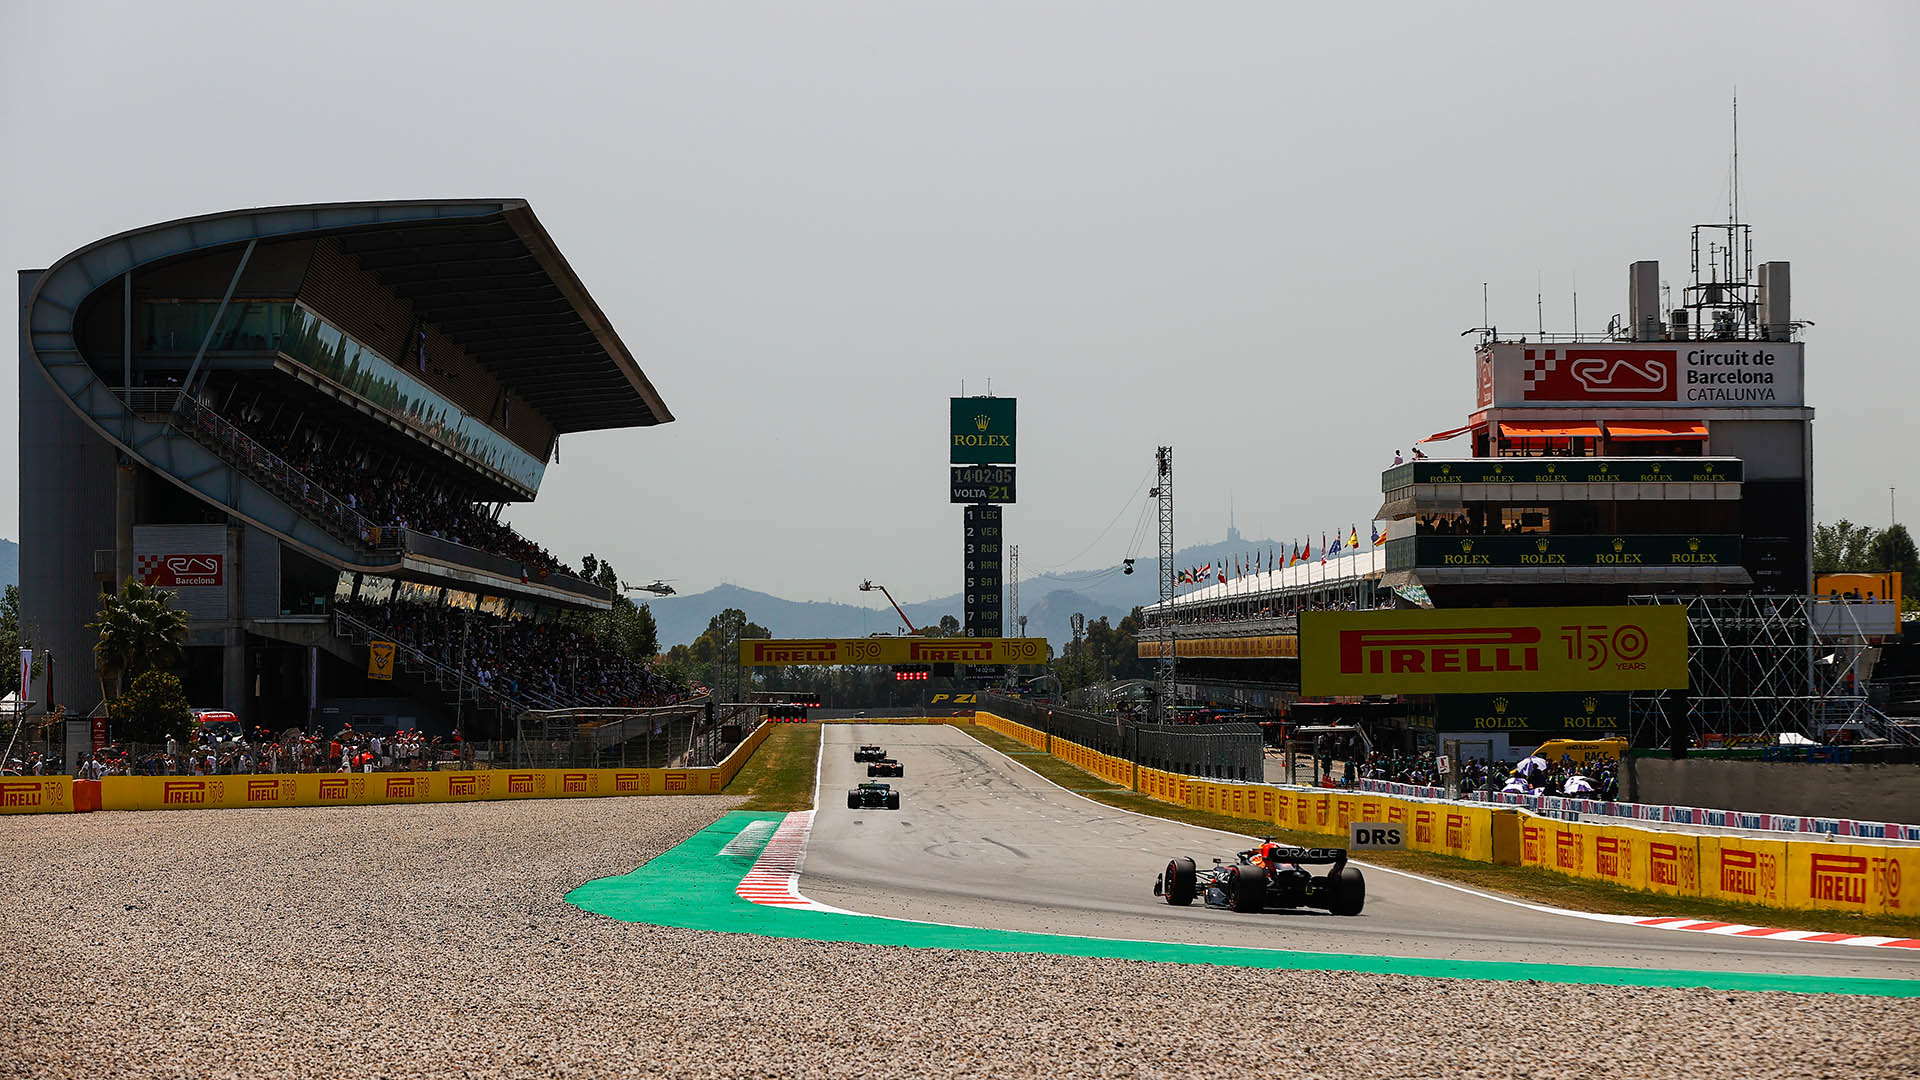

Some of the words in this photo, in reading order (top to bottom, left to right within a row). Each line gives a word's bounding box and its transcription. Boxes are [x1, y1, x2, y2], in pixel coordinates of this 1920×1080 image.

[1687, 350, 1748, 366] Circuit
[1752, 350, 1775, 366] de
[1687, 369, 1775, 385] Barcelona
[1687, 388, 1776, 401] CATALUNYA
[954, 435, 1011, 447] ROLEX
[955, 469, 1012, 484] 14:02:05
[1693, 474, 1725, 482] ROLEX
[954, 488, 987, 498] VOLTA
[988, 486, 1010, 500] 21
[967, 511, 975, 520] 1
[981, 511, 998, 519] LEC
[967, 527, 975, 536] 2
[981, 527, 998, 535] VER
[967, 544, 975, 554] 3
[981, 544, 998, 553] RUS
[967, 561, 975, 570] 4
[1444, 554, 1490, 565] ROLEX
[1520, 554, 1566, 565] ROLEX
[1596, 553, 1642, 564] ROLEX
[1672, 553, 1718, 564] ROLEX
[175, 577, 216, 585] Barcelona
[967, 578, 975, 587] 5
[967, 594, 975, 604] 6
[981, 594, 998, 603] PER
[967, 611, 975, 621] 7
[967, 628, 975, 637] 8
[754, 642, 837, 662] PIRELLI
[845, 641, 881, 661] 150
[910, 641, 993, 661] PIRELLI
[1001, 641, 1037, 661] 150
[1340, 626, 1541, 674] PIRELLI
[1560, 625, 1649, 671] 150
[1615, 662, 1647, 671] YEARS
[931, 693, 950, 704] P
[1474, 717, 1529, 728] ROLEX
[1563, 717, 1618, 728] ROLEX
[386, 778, 415, 798] PIRELLI
[449, 775, 476, 796] PIRELLI
[508, 774, 534, 793] PIRELLI
[563, 774, 587, 792] PIRELLI
[616, 773, 639, 791] PIRELLI
[0, 783, 41, 807] PIRELLI
[164, 782, 205, 804] PIRELLI
[248, 780, 279, 801] PIRELLI
[319, 779, 349, 800] PIRELLI
[1356, 829, 1401, 846] DRS
[1275, 848, 1338, 860] ORACLE
[1556, 830, 1574, 869] PIRELLI
[1596, 836, 1618, 877] PIRELLI
[1650, 842, 1678, 887] PIRELLI
[1720, 847, 1757, 896] PIRELLI
[1810, 853, 1867, 904] PIRELLI
